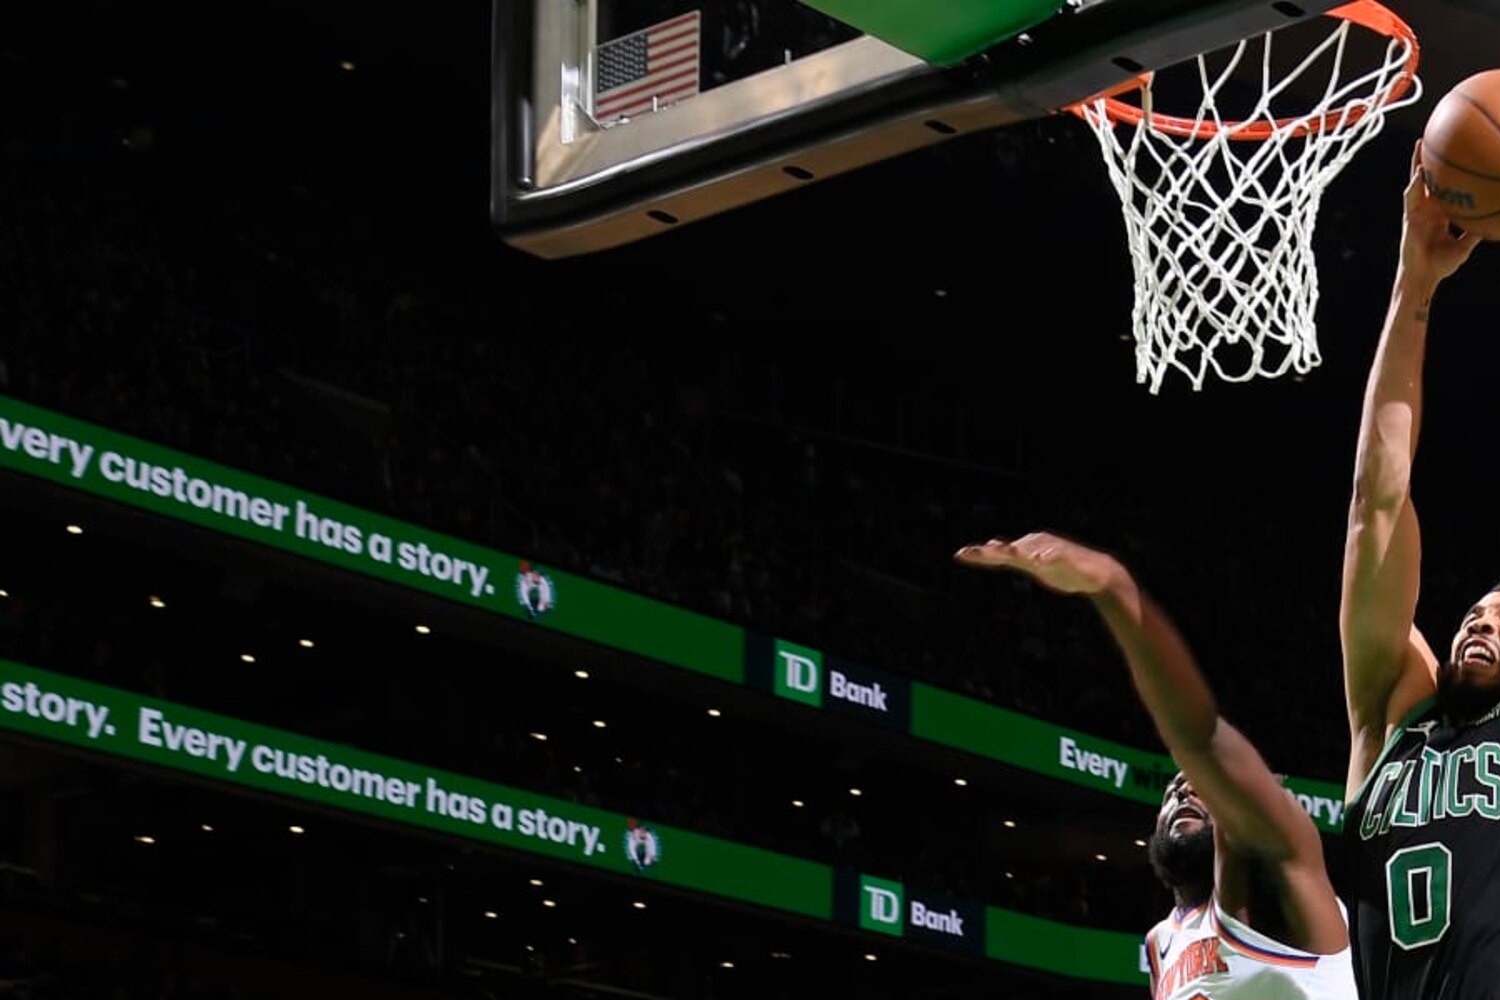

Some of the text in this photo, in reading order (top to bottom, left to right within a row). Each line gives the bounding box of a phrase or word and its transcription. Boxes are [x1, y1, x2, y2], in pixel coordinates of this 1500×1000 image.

[0, 418, 495, 597] very customer has a story.
[779, 650, 888, 712] TD Bank
[1, 682, 606, 856] story. Every customer has a story.
[1059, 736, 1128, 789] Every
[1295, 792, 1345, 826] ory.
[864, 885, 964, 937] TD Bank
[1385, 841, 1453, 951] 0
